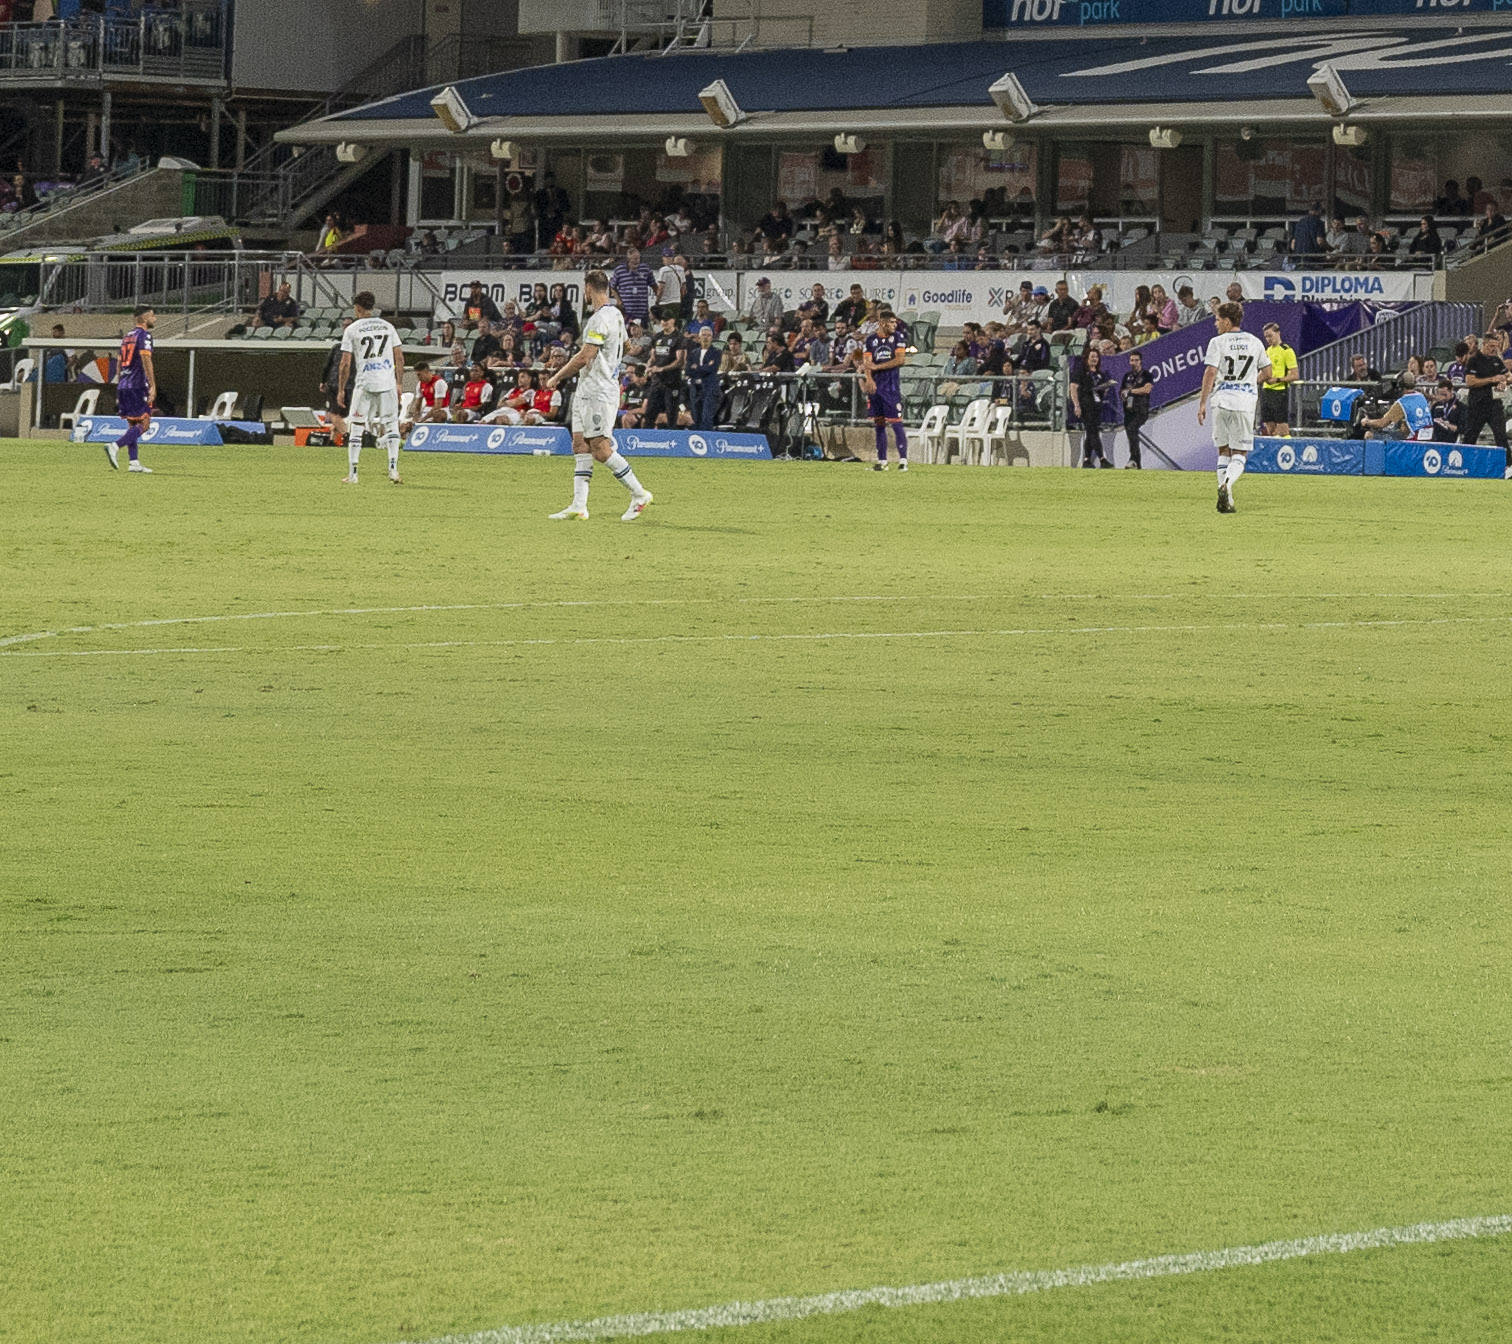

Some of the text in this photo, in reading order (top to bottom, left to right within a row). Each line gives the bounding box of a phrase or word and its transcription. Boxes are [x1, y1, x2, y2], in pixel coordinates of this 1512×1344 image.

[1301, 276, 1384, 294] DIPLOMA
[923, 289, 973, 303] Goodlife
[361, 334, 389, 359] 27
[1224, 355, 1254, 380] 17
